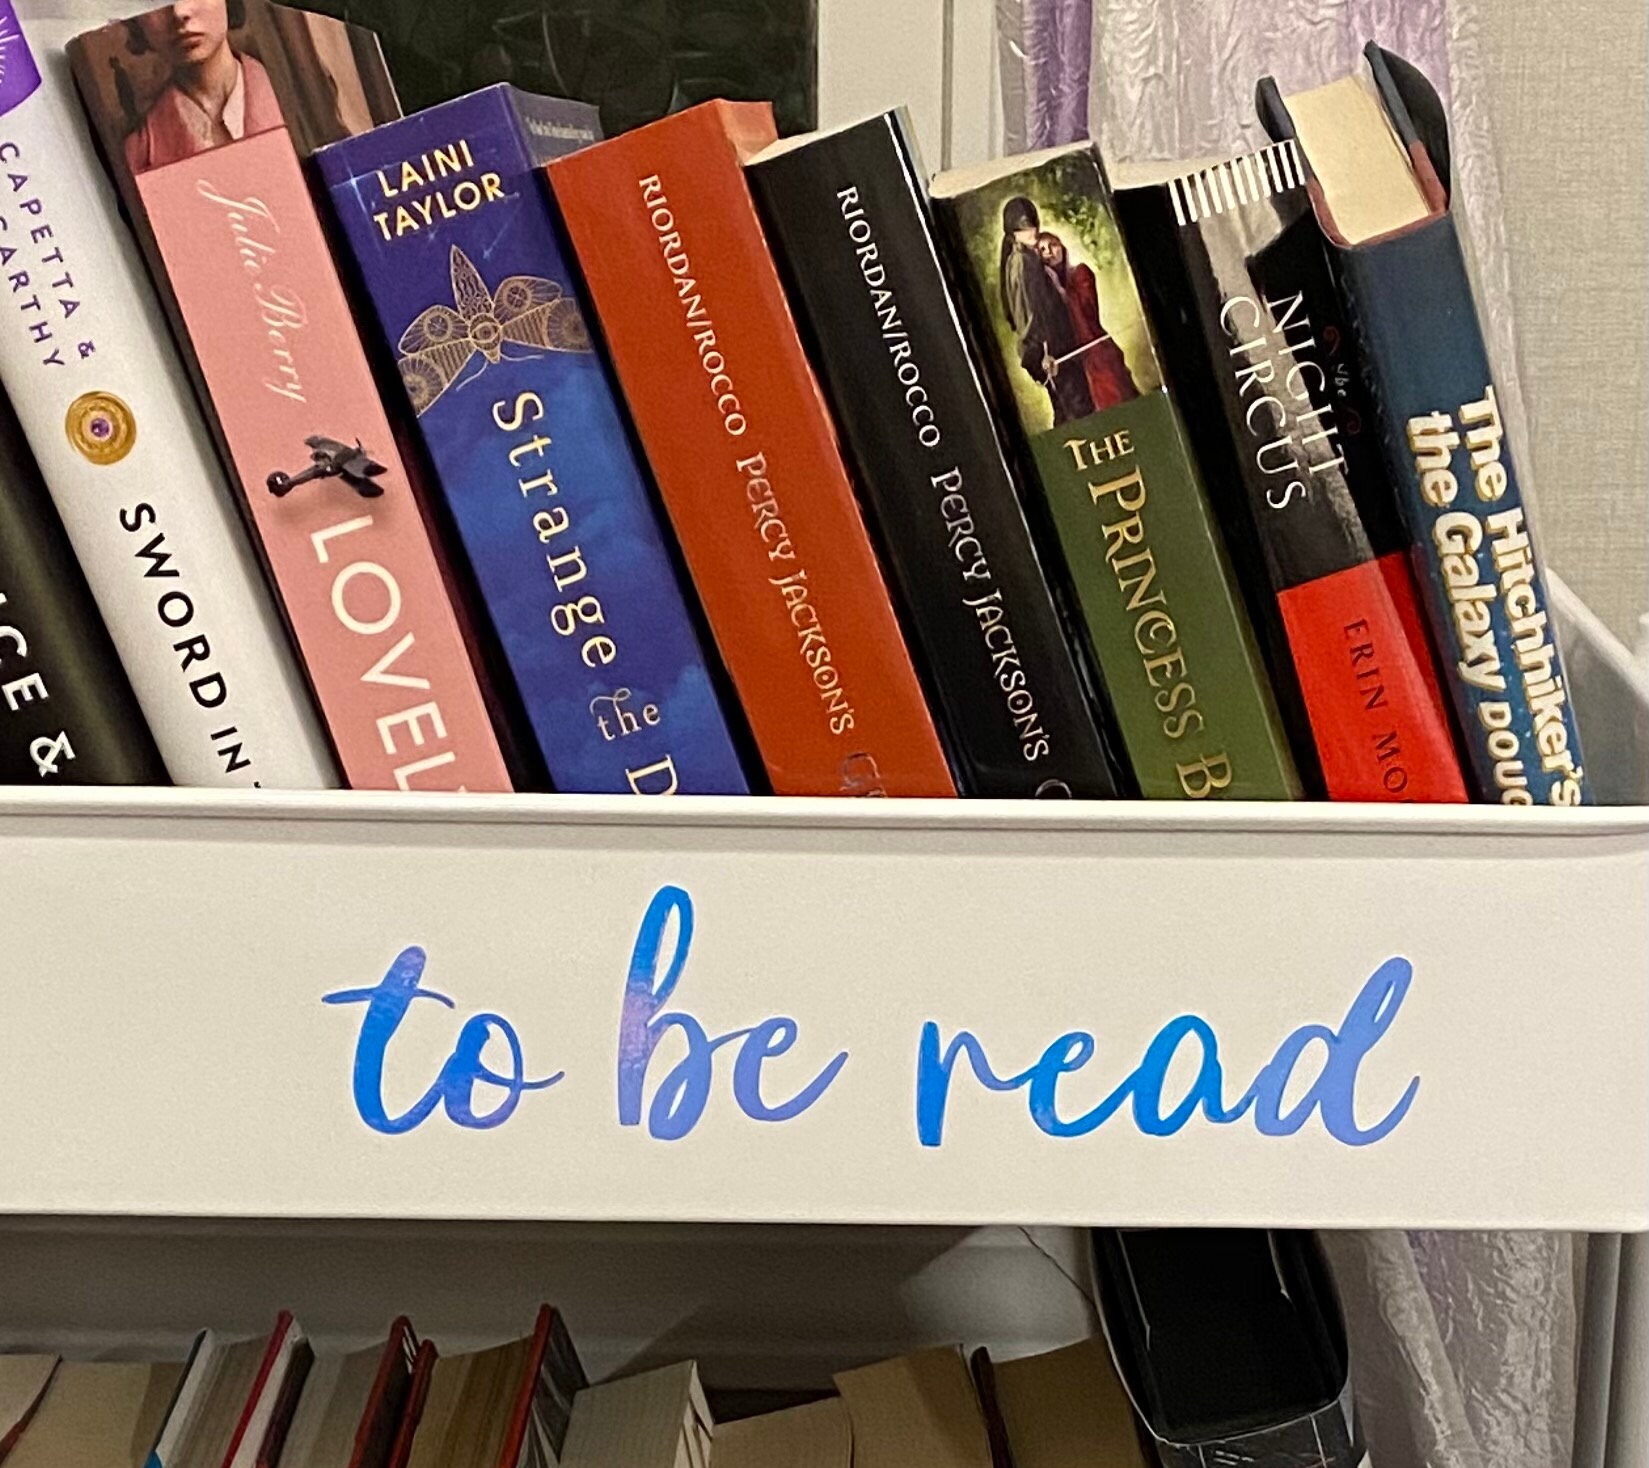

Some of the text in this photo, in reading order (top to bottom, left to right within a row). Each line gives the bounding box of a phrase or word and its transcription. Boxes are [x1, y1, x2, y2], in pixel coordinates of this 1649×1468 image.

[0, 142, 96, 360] CAPETTA &
[196, 178, 308, 403] Julie Berry
[373, 172, 505, 242] TAYLOR
[376, 138, 475, 199] LAINI
[638, 172, 748, 437] RIORDAN/ROCCO
[736, 451, 796, 567] PERCY
[769, 568, 855, 735] JACKSON'S
[836, 184, 1051, 762] RIORDAN/ROCCO PERCY JACKSON'S
[1063, 428, 1135, 471] THE
[1220, 296, 1307, 509] CIRCUS
[1261, 289, 1350, 475] NIGHT
[119, 502, 252, 774] SWORD IN
[311, 514, 468, 792] LOVEL
[494, 391, 617, 668] Strange
[589, 686, 661, 742] the
[1087, 463, 1206, 740] PRINCESS
[1406, 410, 1460, 508] the
[1433, 511, 1507, 692] Galaxy
[1459, 385, 1585, 807] The Hitchhiker's
[29, 731, 76, 778] &
[1343, 618, 1413, 802] ERIN MO
[321, 884, 1421, 1148] to be read
